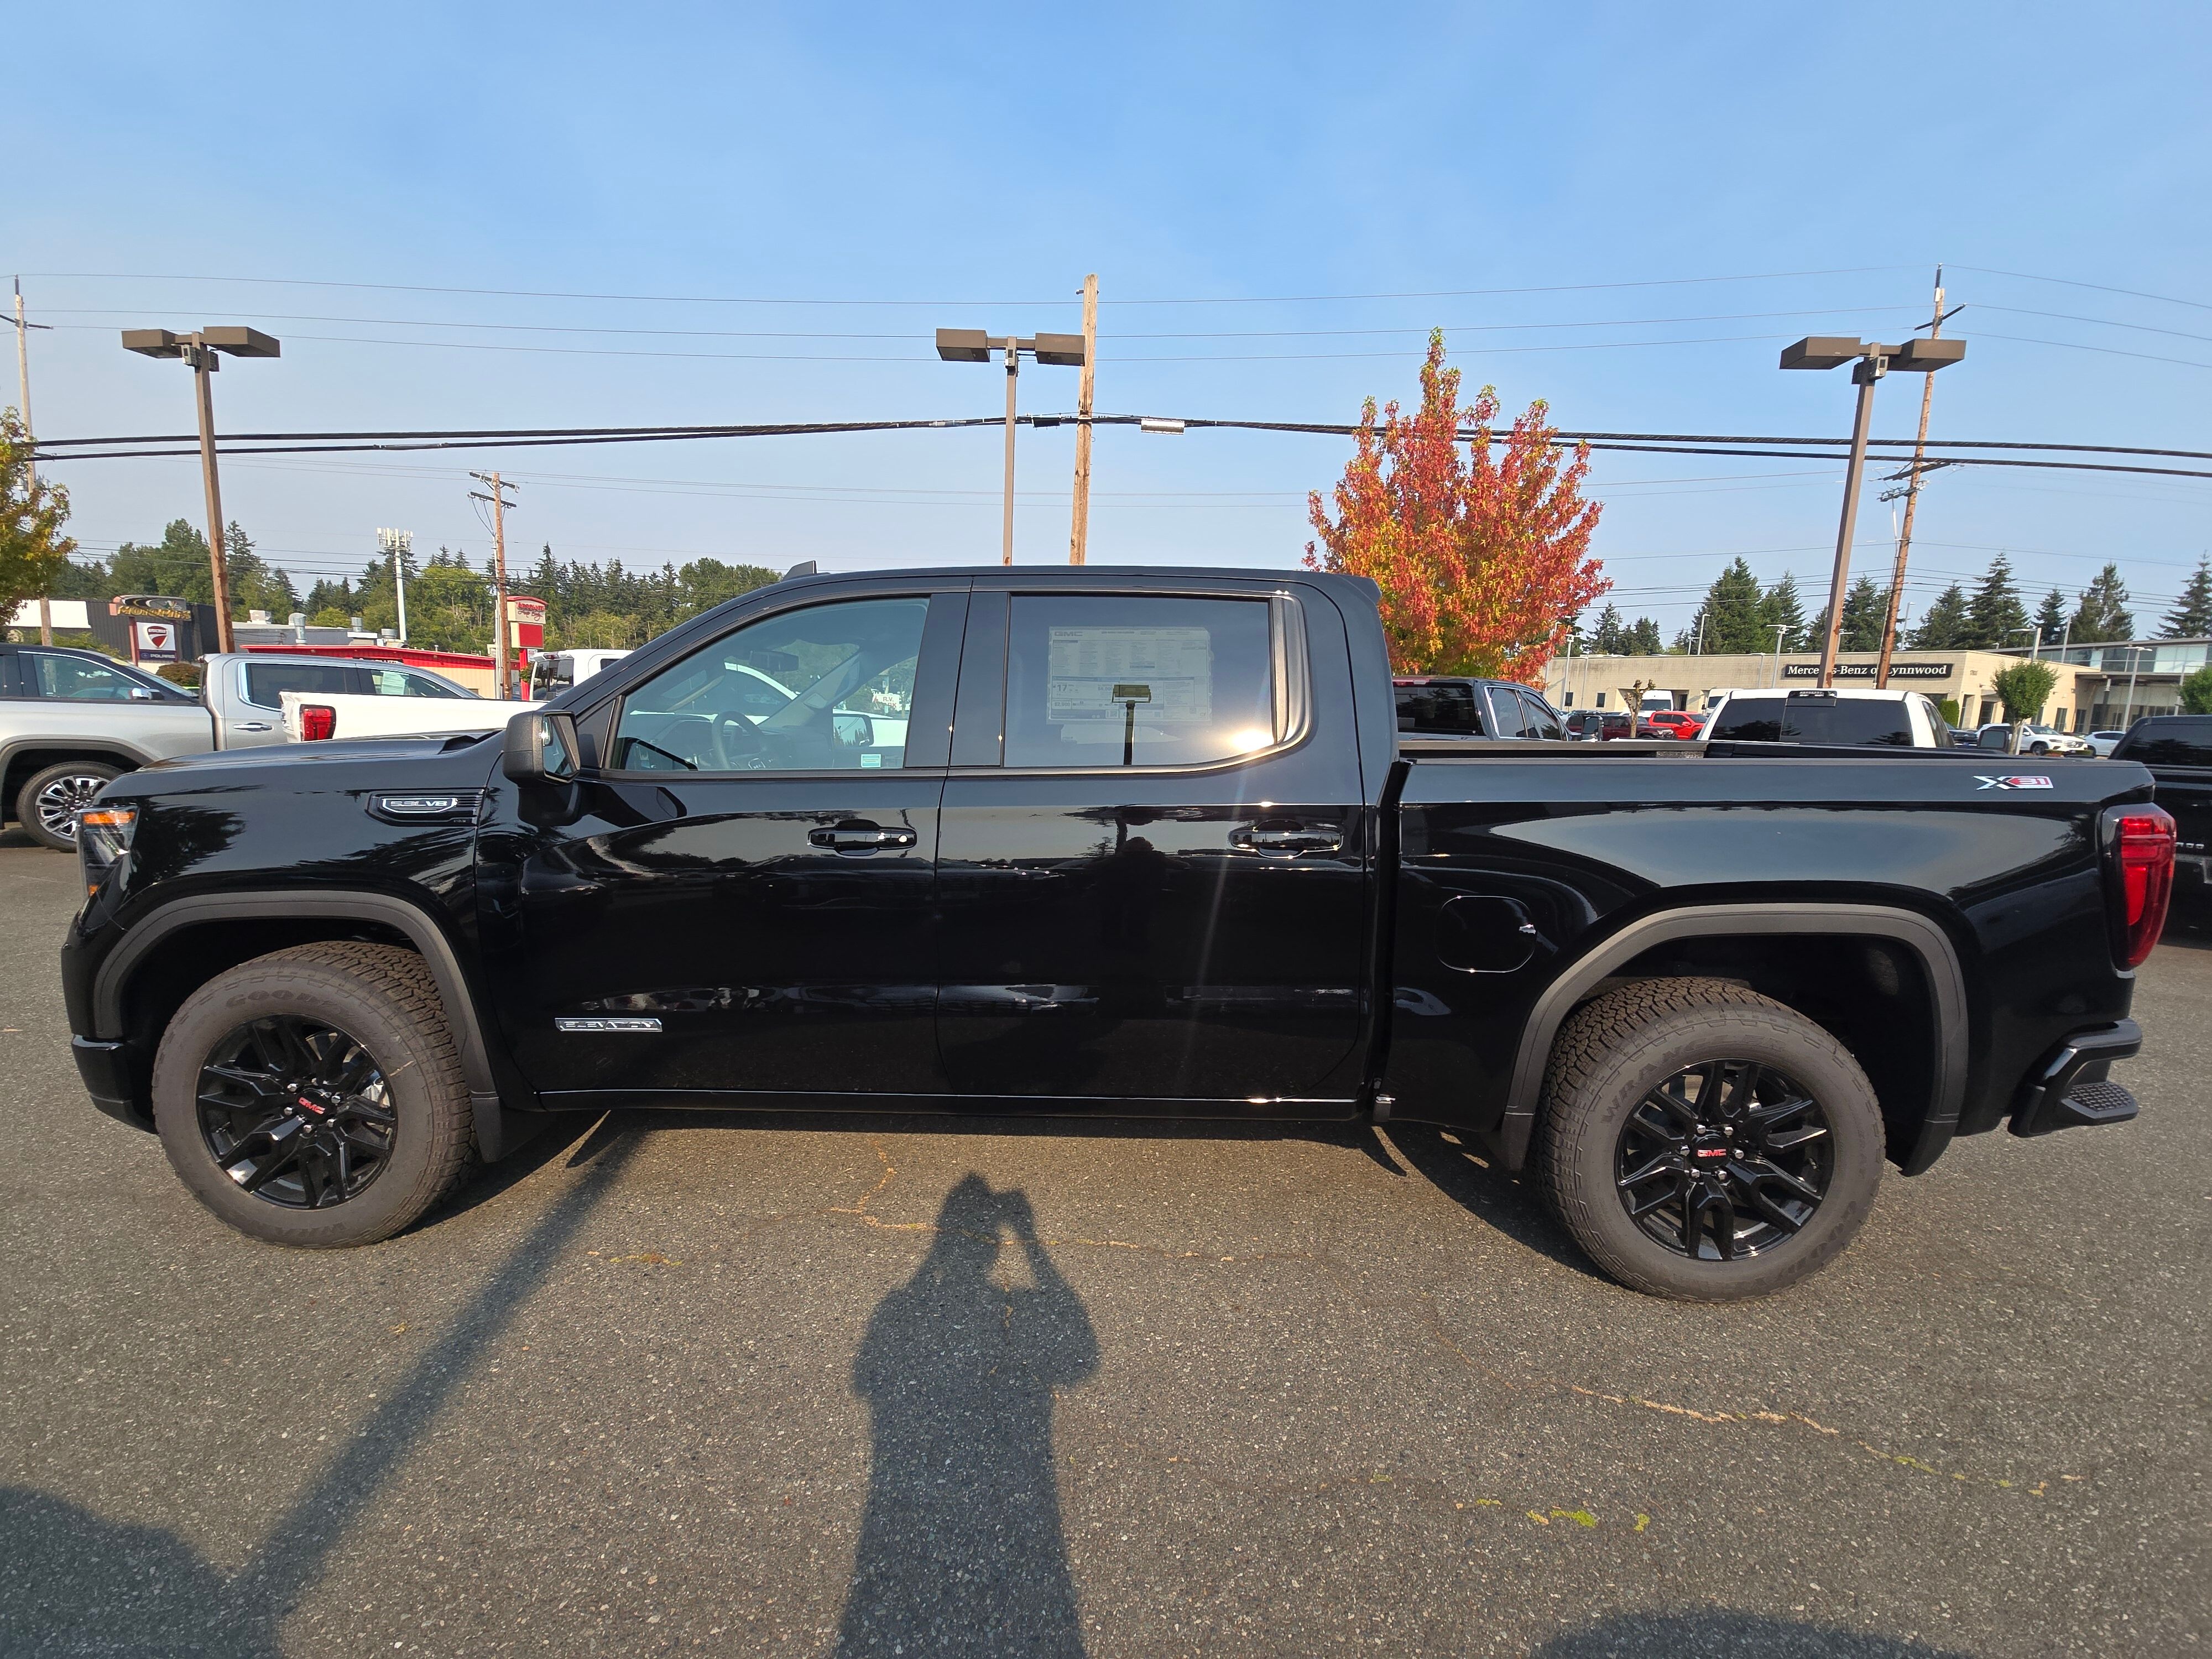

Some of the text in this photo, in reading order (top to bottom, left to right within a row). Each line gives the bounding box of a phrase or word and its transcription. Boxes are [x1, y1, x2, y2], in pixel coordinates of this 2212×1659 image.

[1787, 665, 1867, 675] Merces-Benz
[1972, 775, 2054, 790] X31
[299, 1097, 325, 1114] GMC
